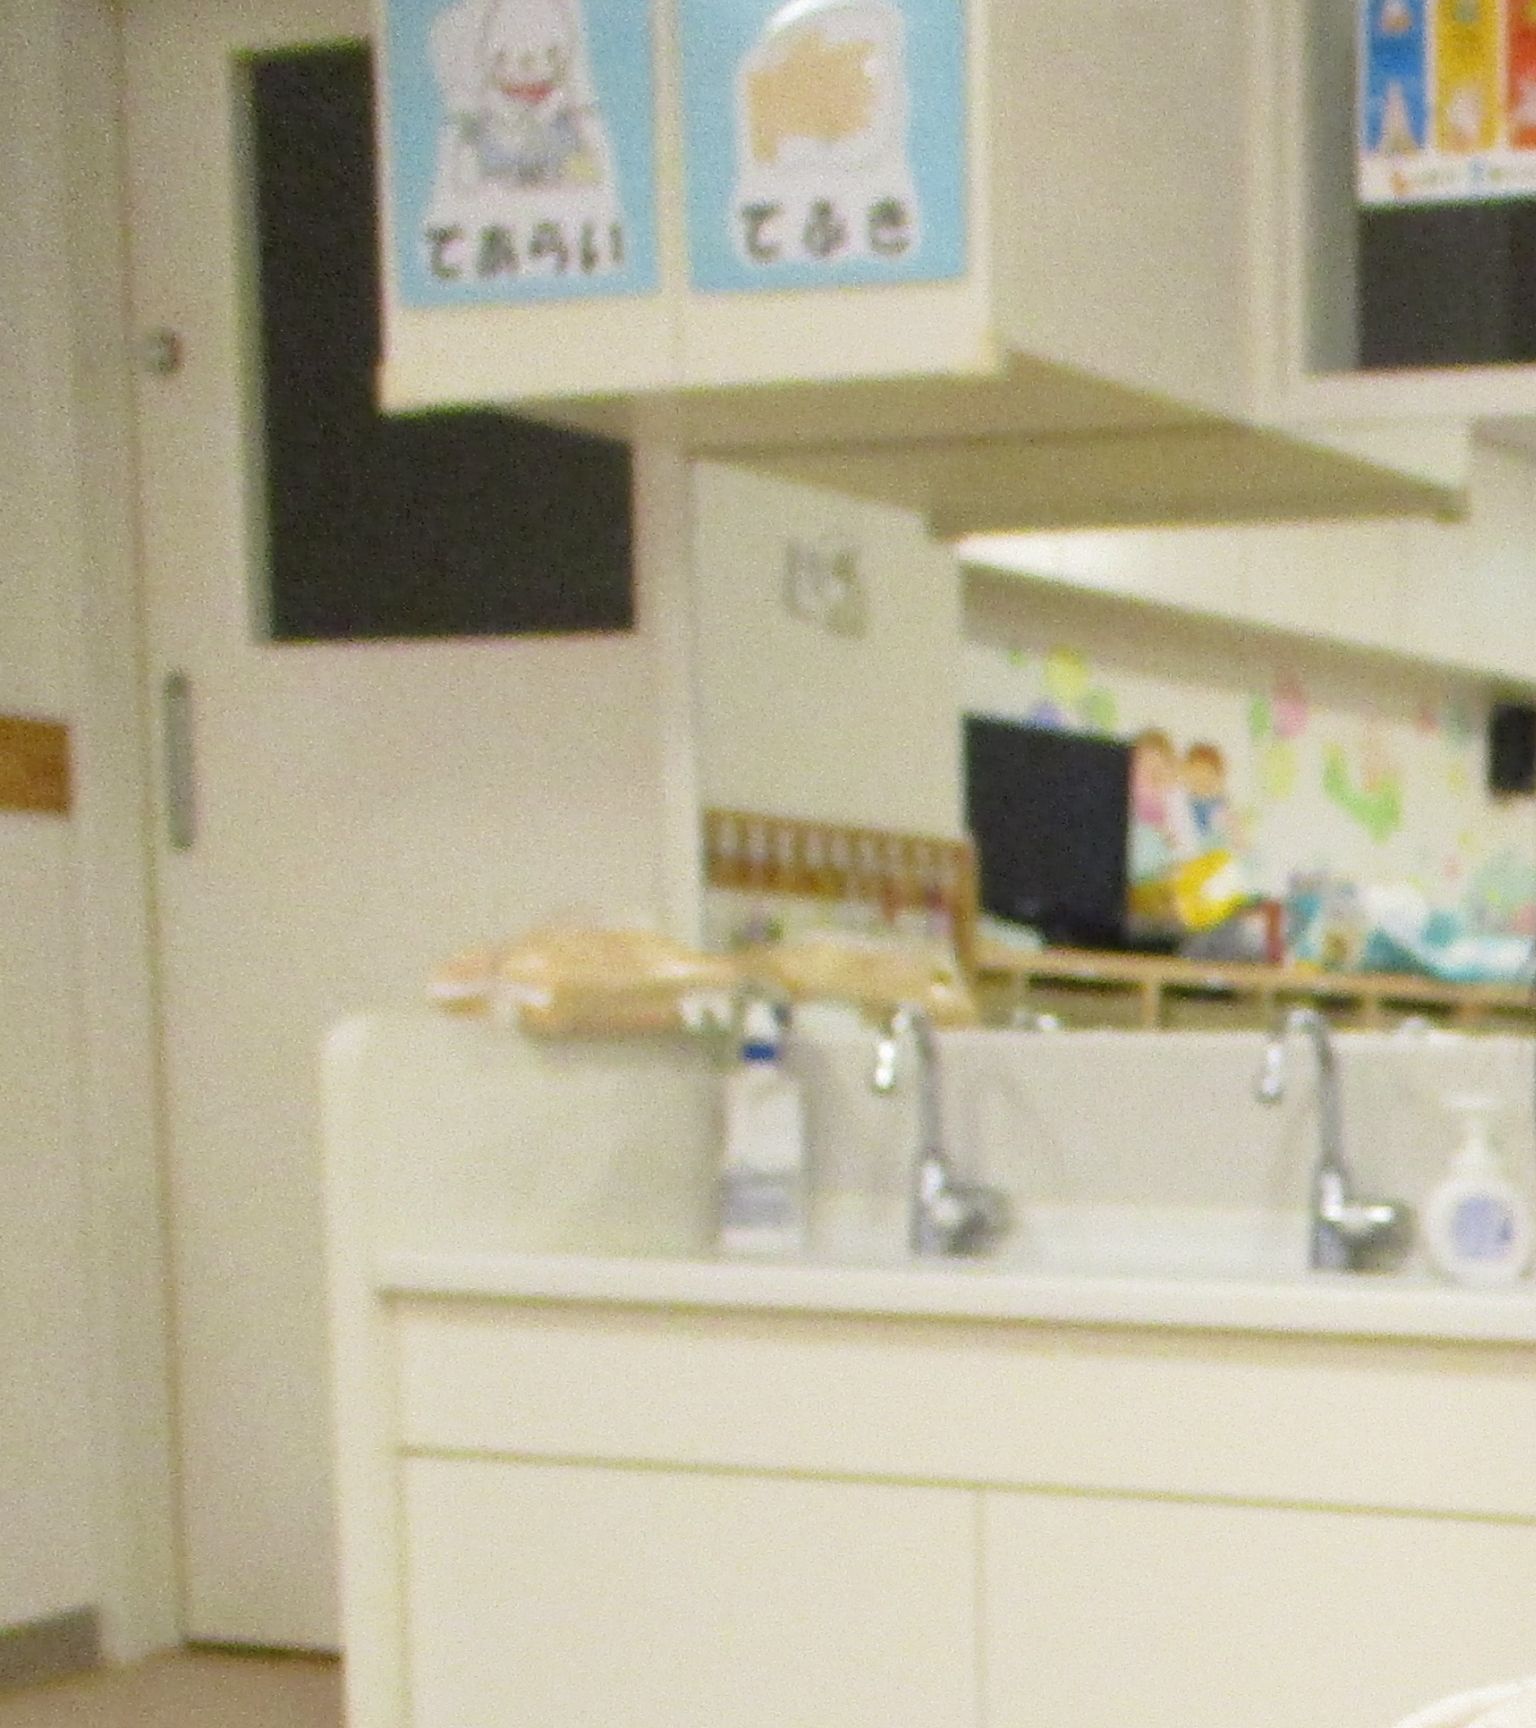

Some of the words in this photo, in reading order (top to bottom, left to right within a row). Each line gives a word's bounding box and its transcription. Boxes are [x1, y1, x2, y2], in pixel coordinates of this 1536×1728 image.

[425, 221, 625, 280] てあらい
[741, 197, 911, 263] てふき
